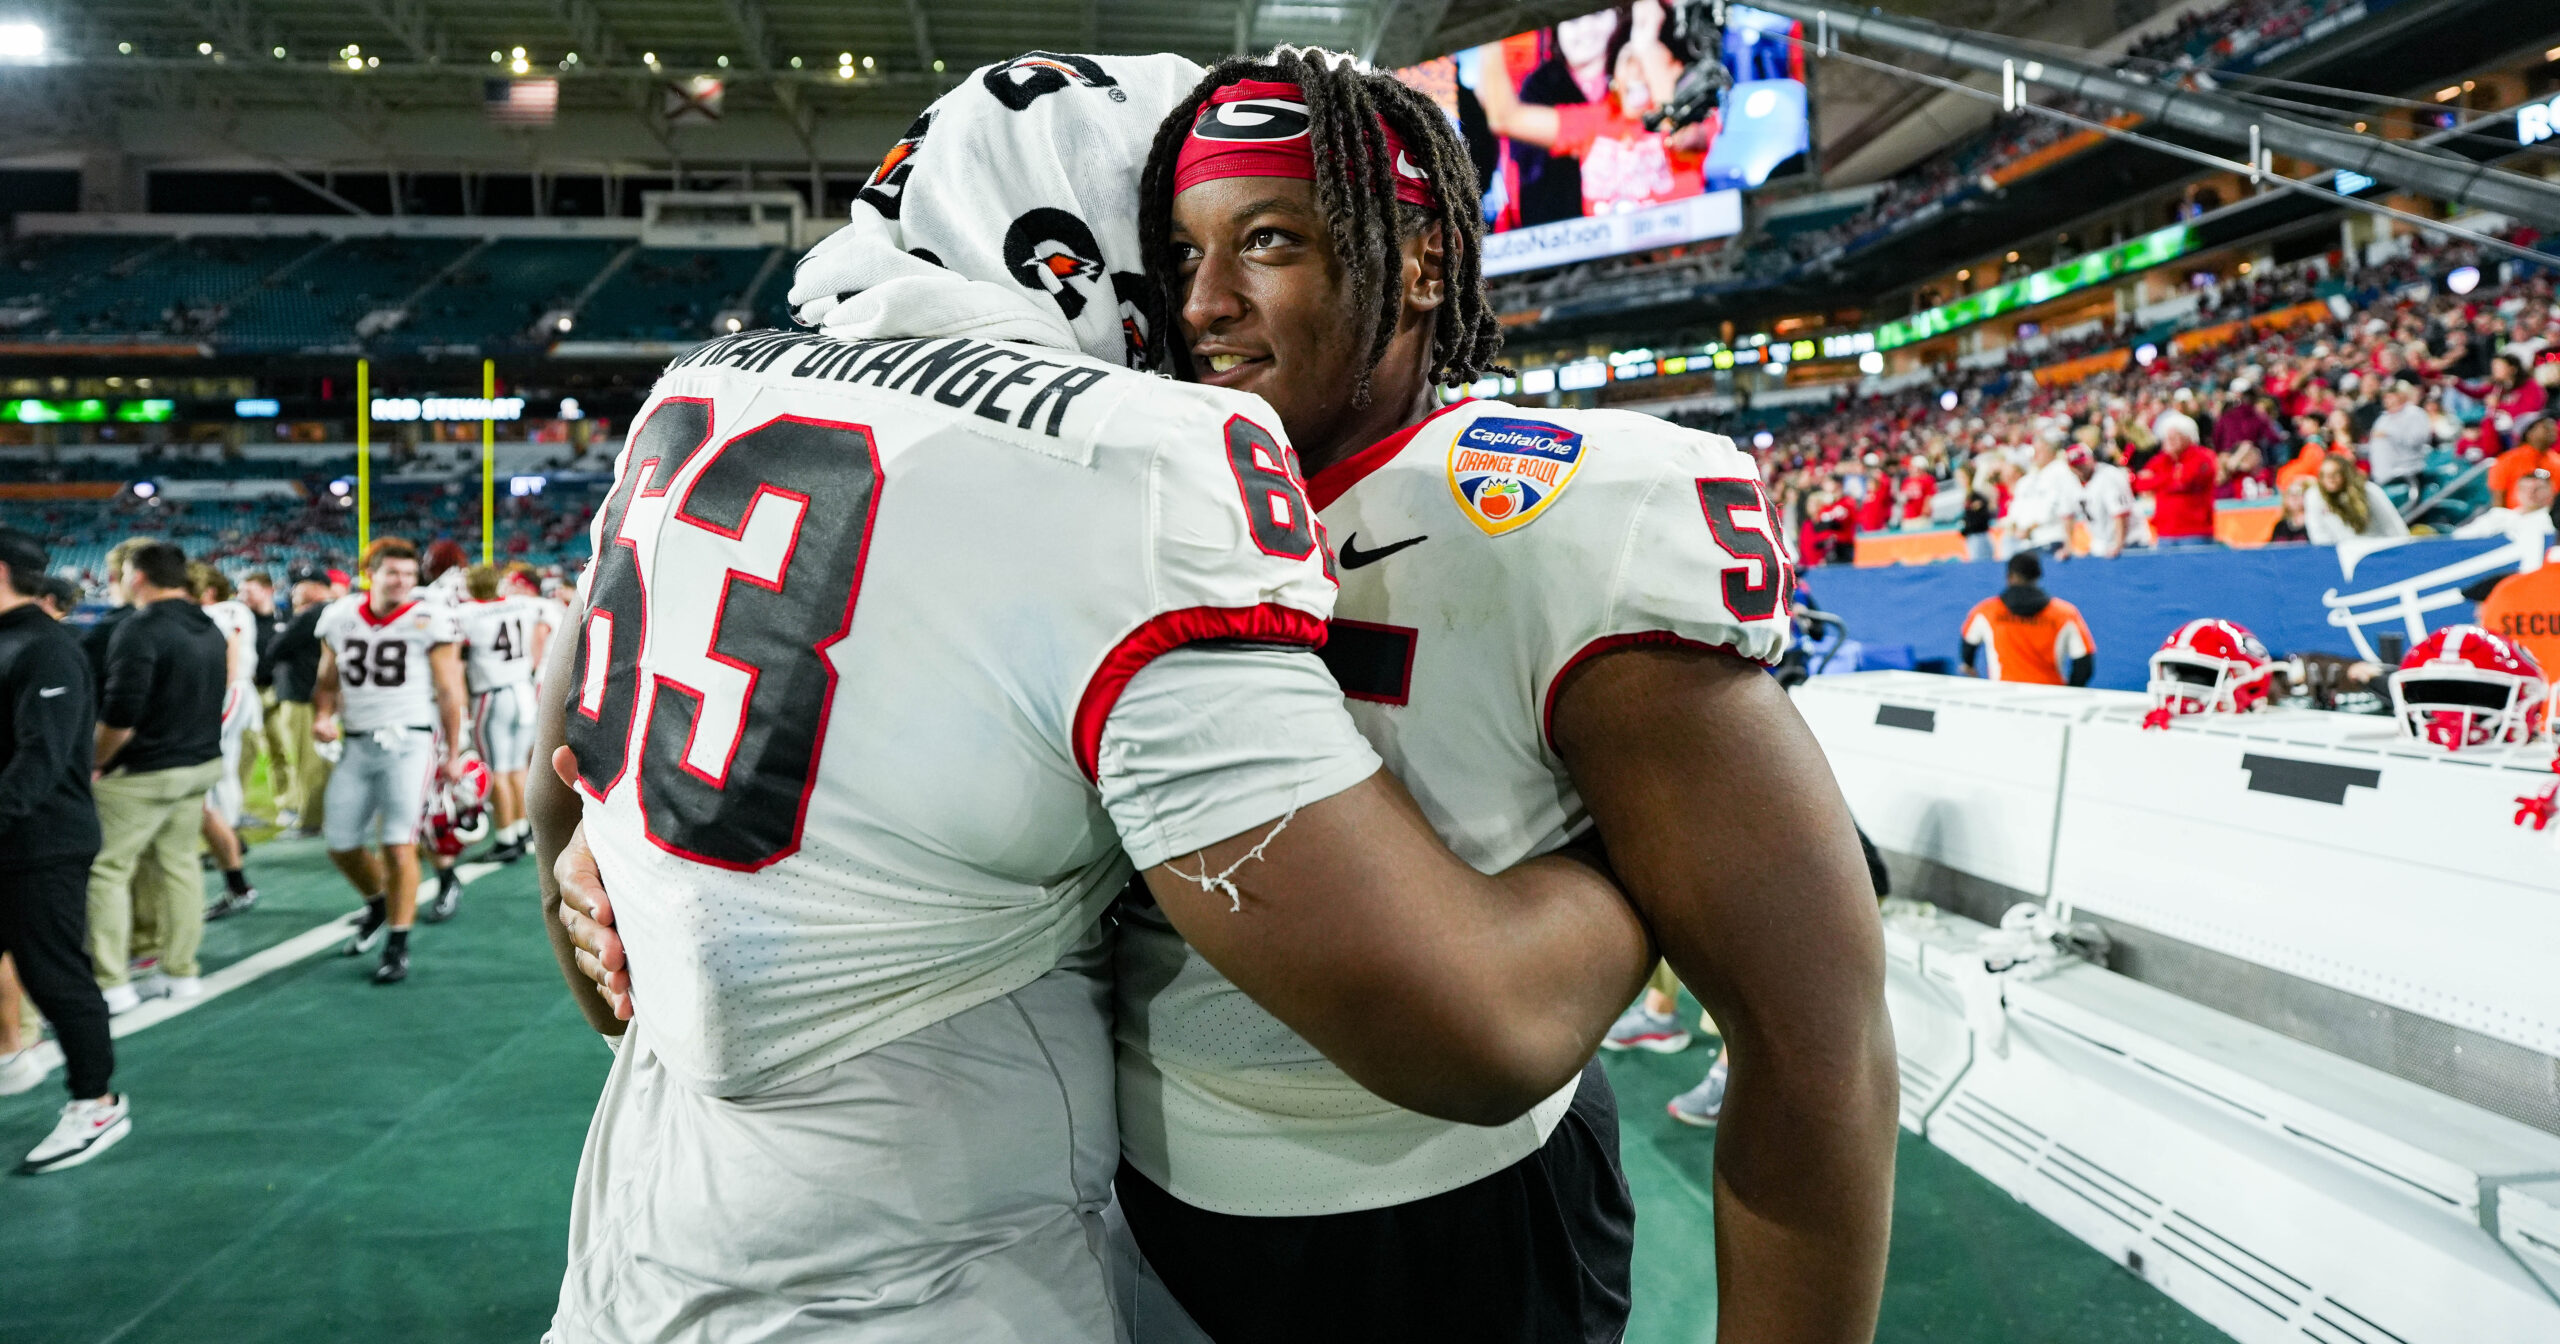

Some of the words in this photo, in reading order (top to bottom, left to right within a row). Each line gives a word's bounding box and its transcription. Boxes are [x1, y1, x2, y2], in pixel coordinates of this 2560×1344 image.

[1455, 450, 1517, 473] ORANGE
[1516, 457, 1560, 487] BOWL
[494, 618, 523, 662] 41
[565, 396, 886, 874] 63
[343, 638, 408, 687] 39
